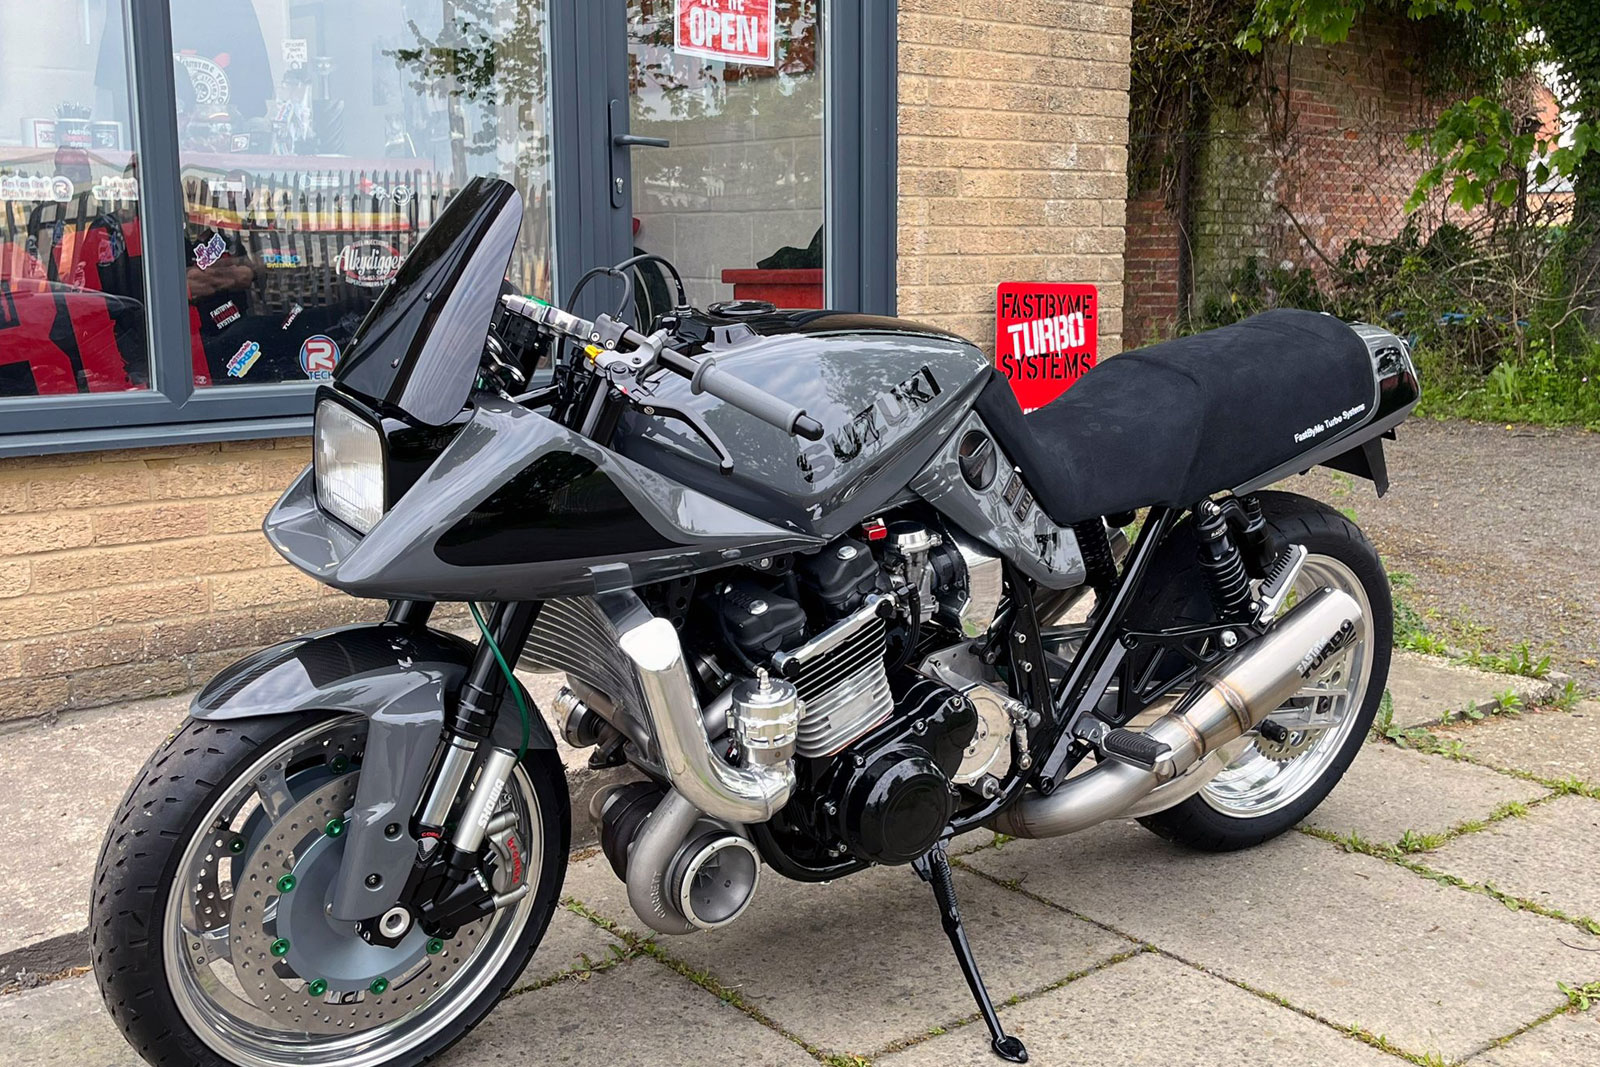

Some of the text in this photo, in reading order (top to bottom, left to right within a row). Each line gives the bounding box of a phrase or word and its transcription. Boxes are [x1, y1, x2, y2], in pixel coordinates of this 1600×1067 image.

[690, 6, 758, 54] OPEN
[1001, 293, 1093, 319] FASTBYME
[229, 342, 259, 376] TURBO
[1007, 311, 1085, 360] TURBO
[1002, 352, 1091, 380] SYSTEMS
[796, 365, 942, 485] SUZUKI
[1324, 415, 1342, 428] Turbo
[1342, 403, 1365, 419] Systems
[1301, 618, 1354, 680] TURBO
[478, 778, 505, 829] SHOWA
